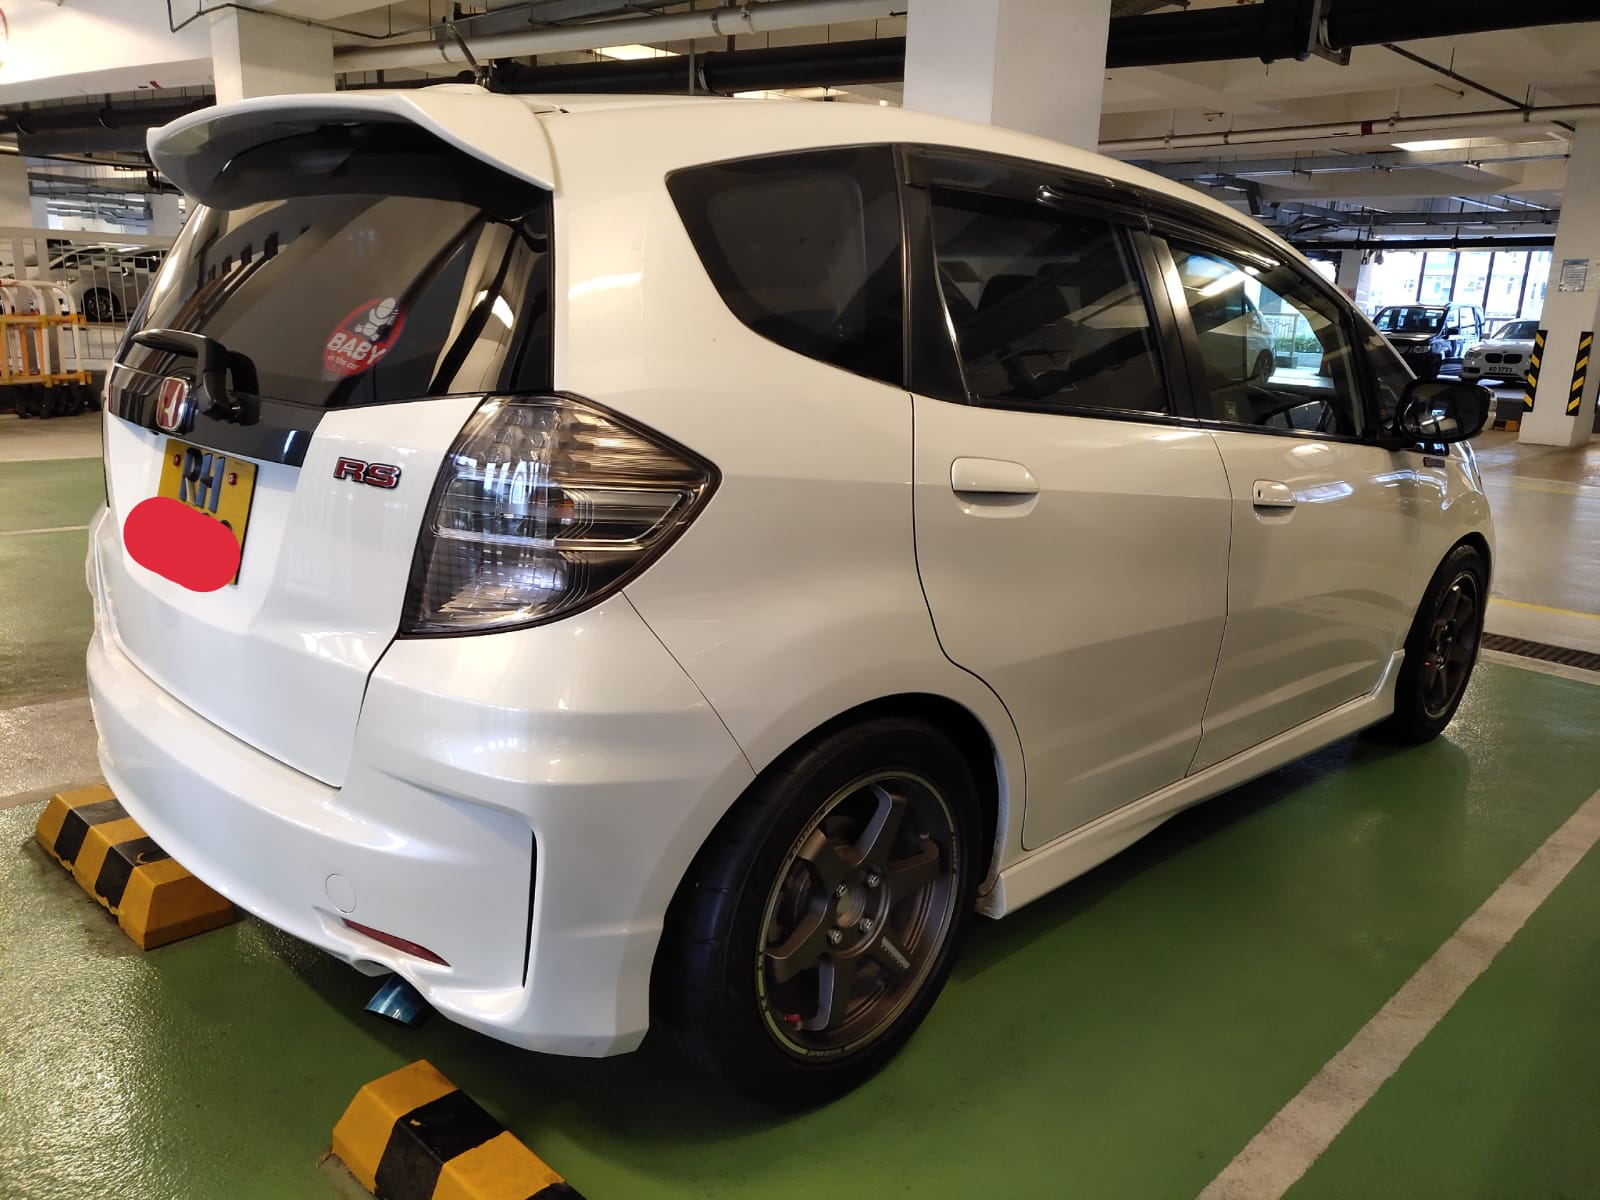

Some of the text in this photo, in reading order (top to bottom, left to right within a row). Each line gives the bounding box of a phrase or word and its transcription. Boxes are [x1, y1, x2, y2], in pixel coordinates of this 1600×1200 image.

[327, 332, 387, 364] BABY
[178, 447, 226, 514] RH
[333, 456, 402, 489] RS
